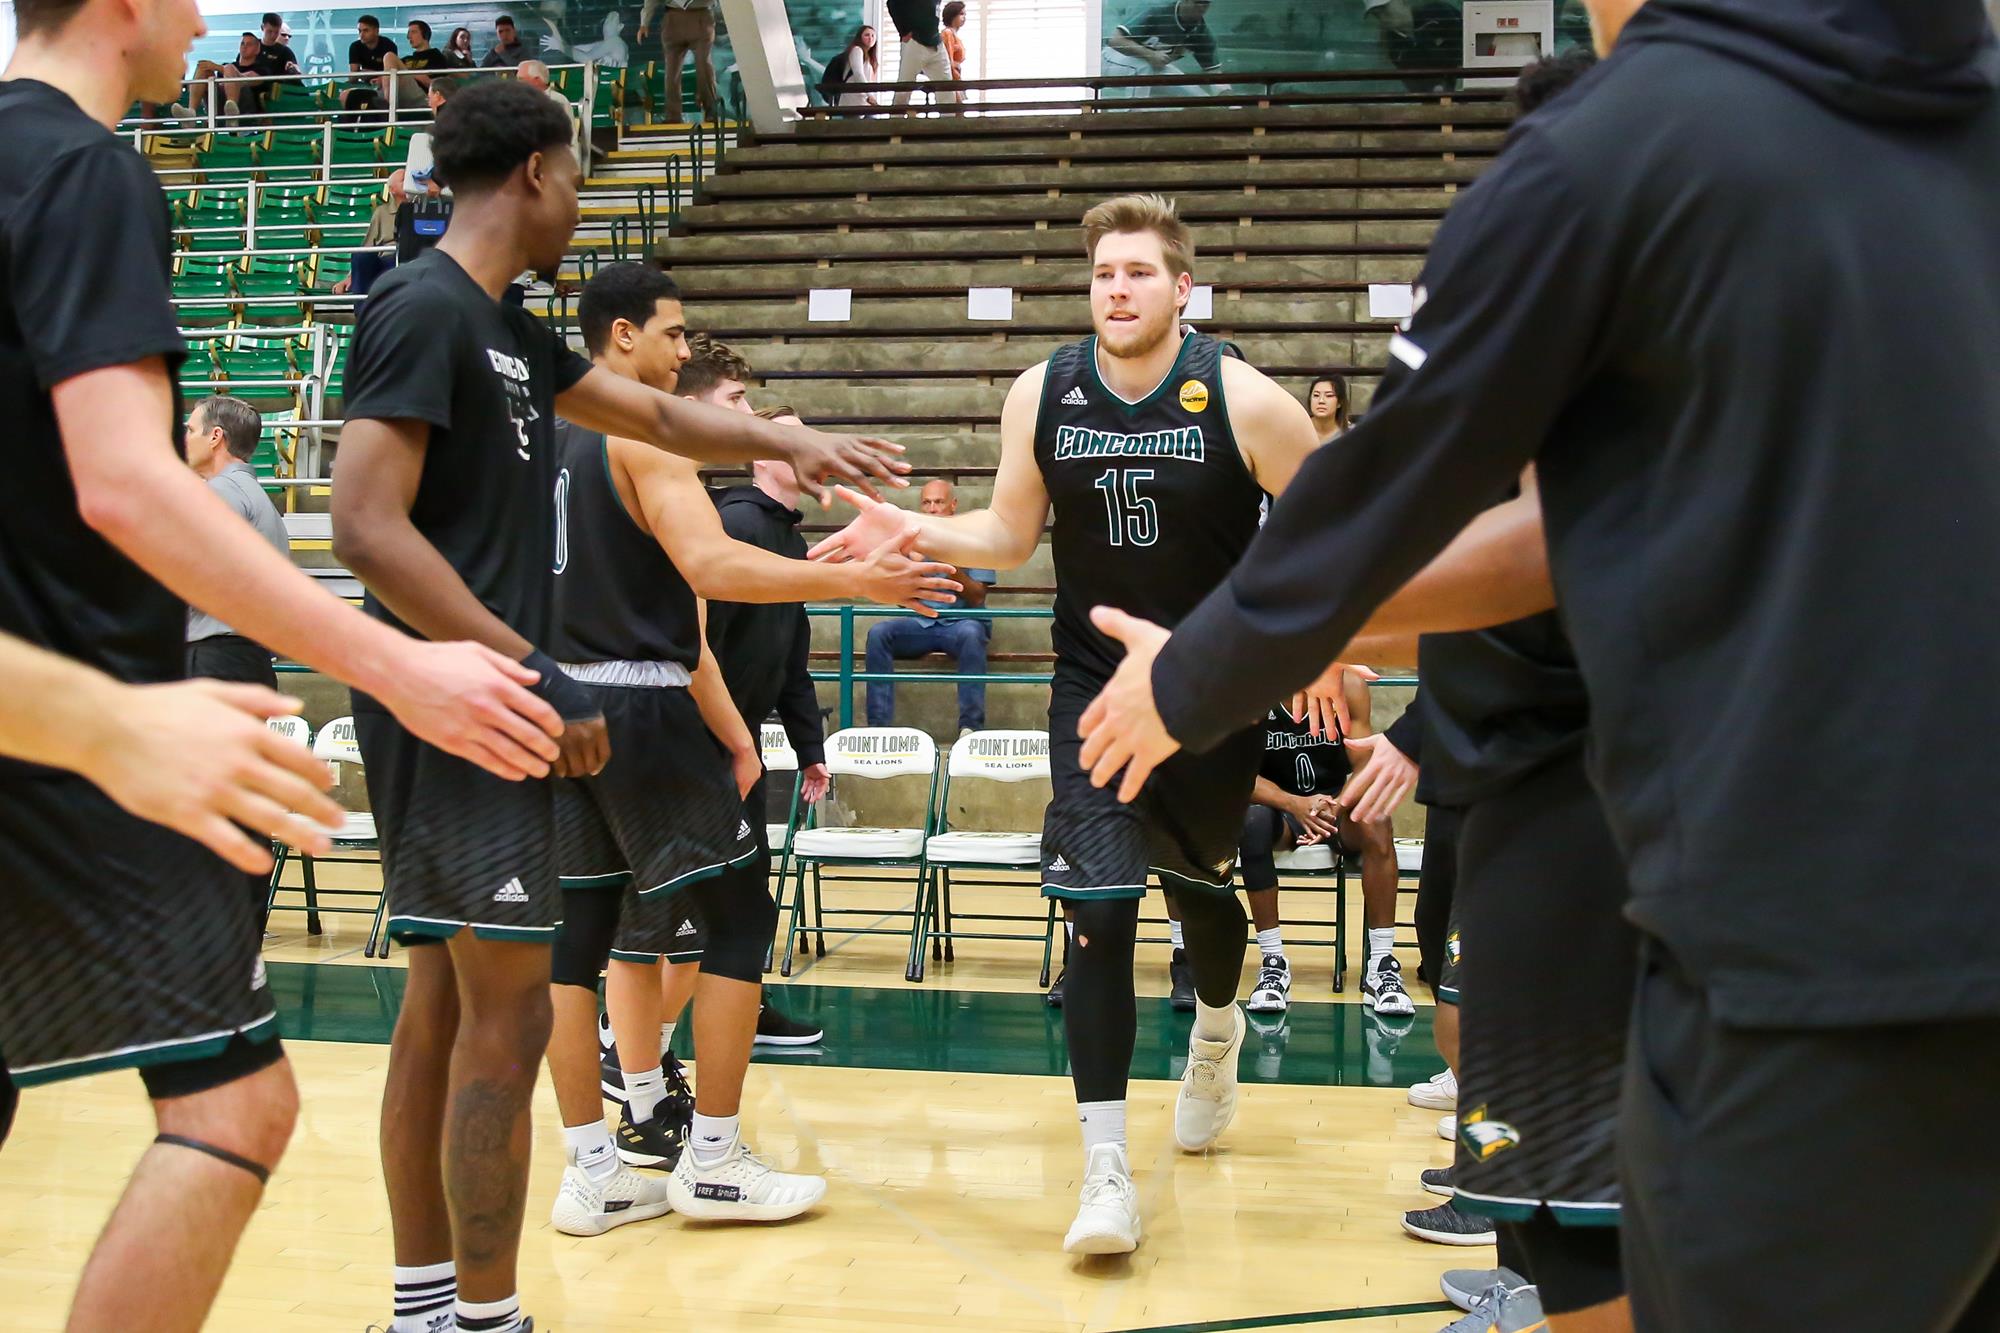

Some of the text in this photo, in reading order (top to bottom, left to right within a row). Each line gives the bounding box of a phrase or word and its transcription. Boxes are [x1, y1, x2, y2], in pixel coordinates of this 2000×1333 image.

[1055, 425, 1205, 463] CONCORDIA
[1095, 469, 1159, 546] 15
[837, 736, 920, 752] POINT LOMA
[968, 738, 1049, 756] POINT LOMA
[1295, 753, 1316, 792] 0
[494, 894, 529, 902] adidas
